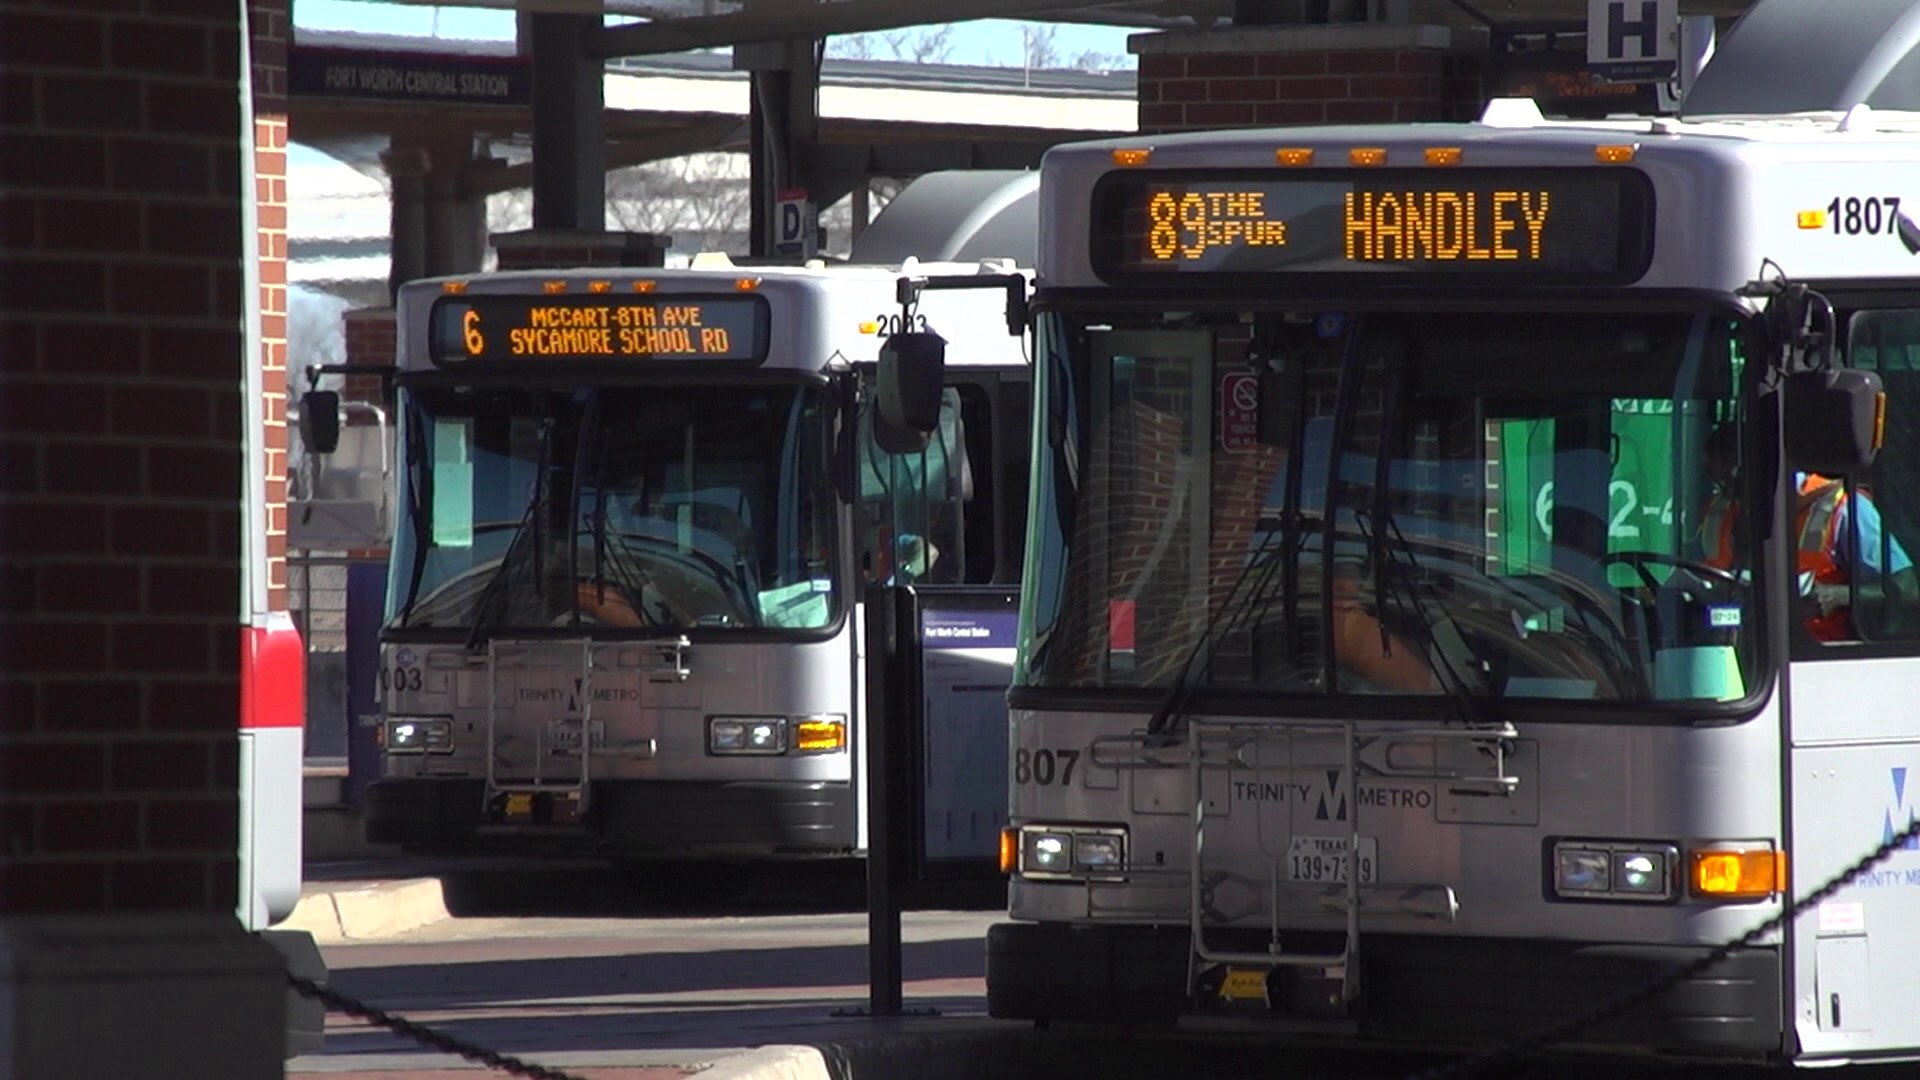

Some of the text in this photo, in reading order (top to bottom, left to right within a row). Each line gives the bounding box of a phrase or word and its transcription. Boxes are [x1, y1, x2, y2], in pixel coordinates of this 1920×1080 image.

[1607, 2, 1658, 59] H
[405, 71, 458, 94] CENTRAL
[460, 74, 508, 97] STATION
[1207, 192, 1265, 217] THE
[1827, 196, 1901, 236] 1807
[783, 203, 799, 241] D
[1150, 192, 1206, 260] 89
[1206, 221, 1287, 246] SPUR
[1345, 192, 1550, 260] HANDLEY
[462, 309, 484, 355] 6
[531, 306, 702, 327] MCCART-8TH AVE
[510, 328, 730, 355] SYCAMORE SCHOOL RD
[594, 688, 640, 702] METRO
[1015, 747, 1080, 786] 807
[1233, 782, 1431, 808] TRINITY METRO
